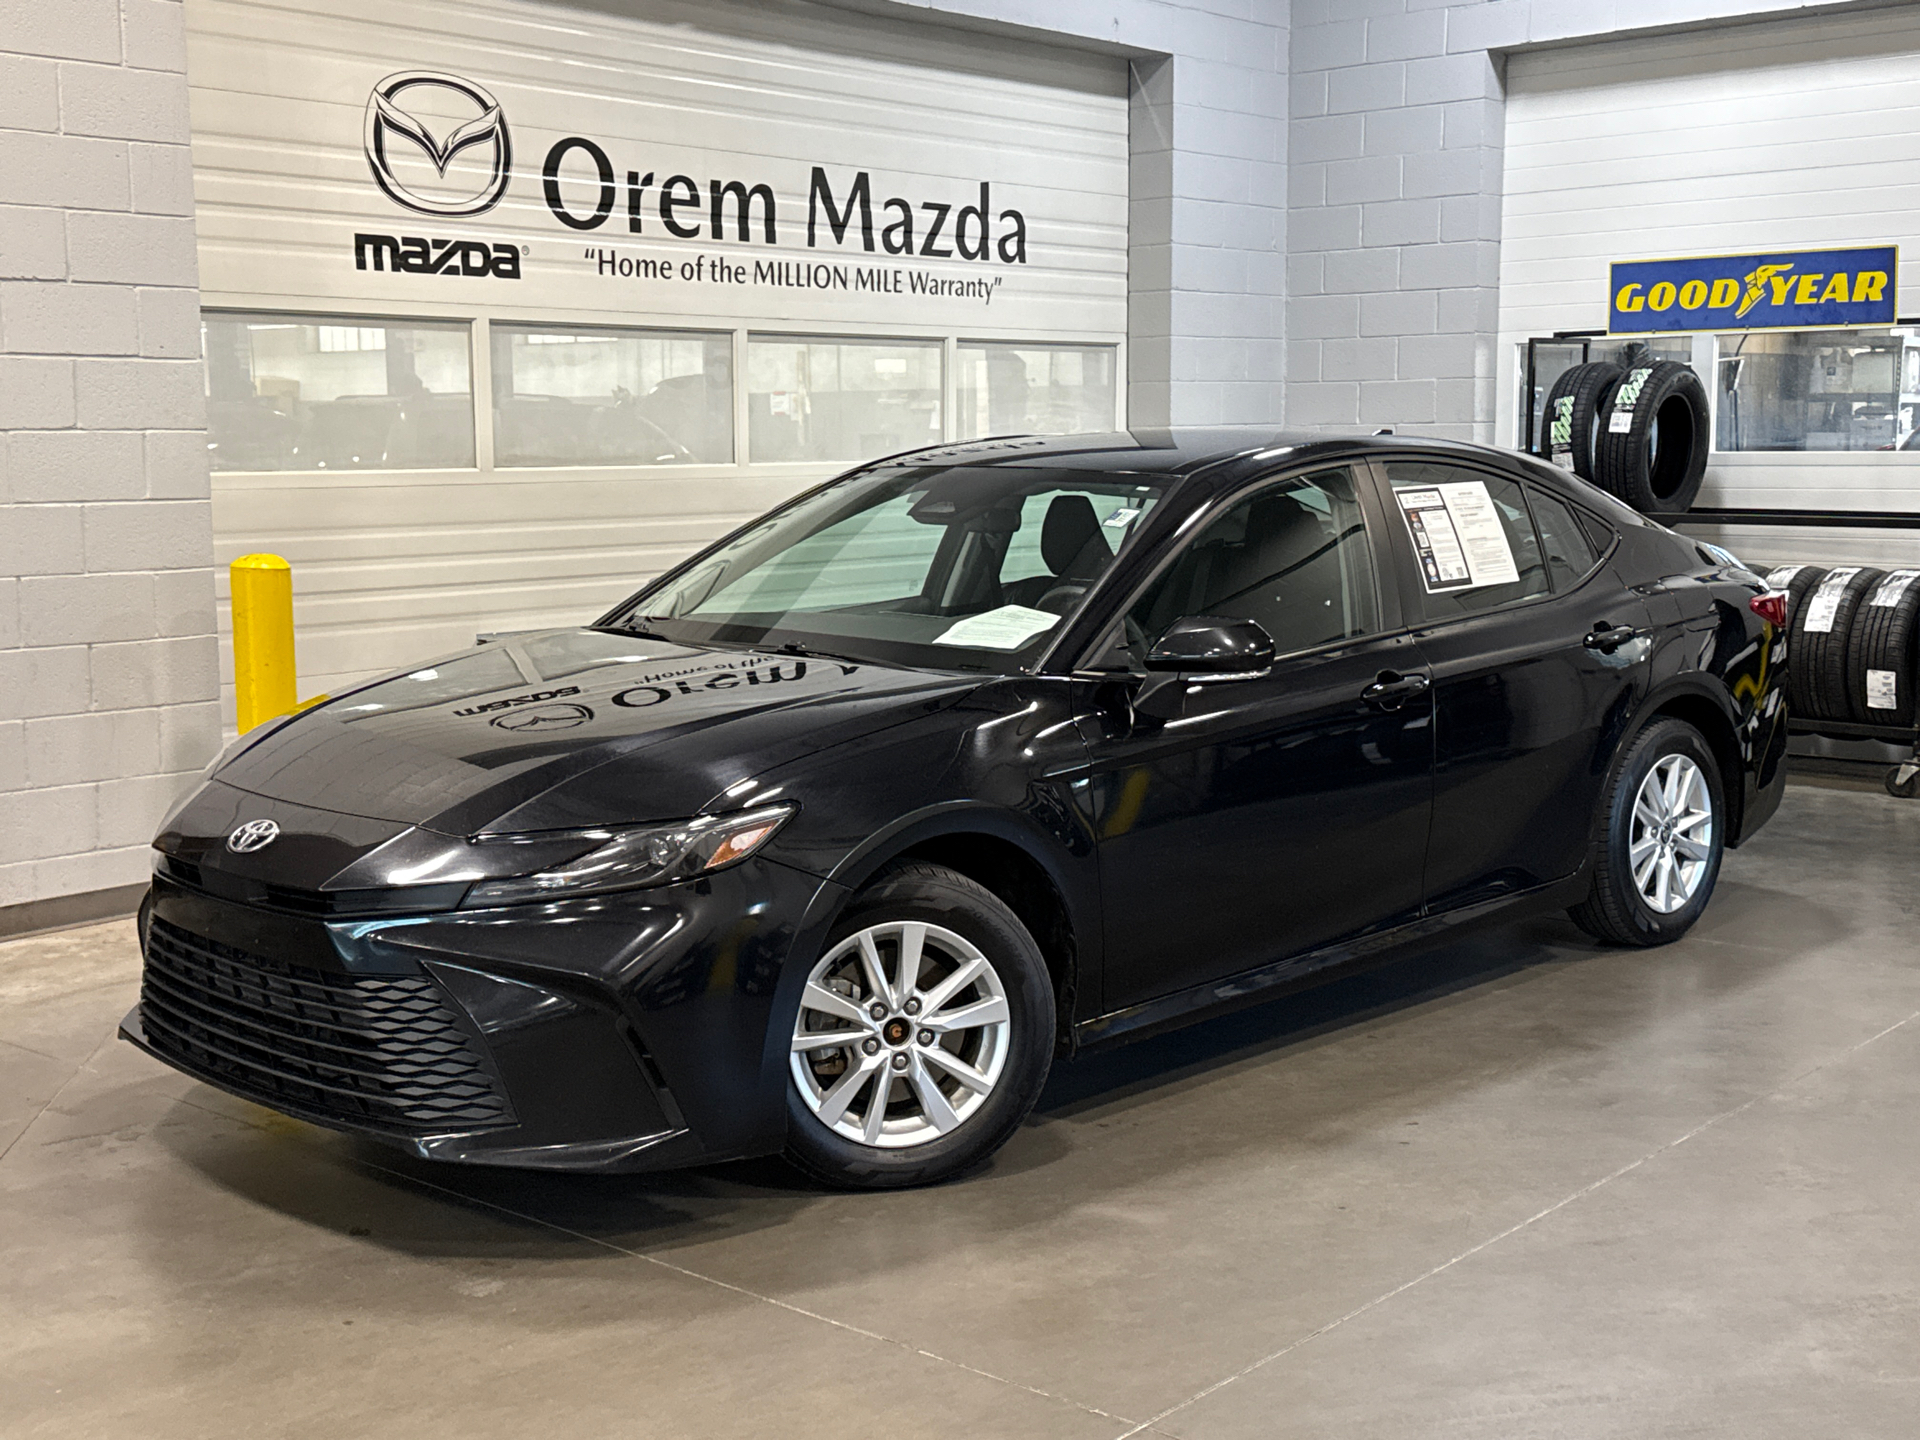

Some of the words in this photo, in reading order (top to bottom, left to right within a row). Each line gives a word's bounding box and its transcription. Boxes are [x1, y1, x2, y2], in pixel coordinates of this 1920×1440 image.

[542, 137, 776, 244] Orem
[807, 166, 1027, 264] Mazda
[354, 233, 521, 279] mazda
[584, 248, 673, 280] “Home
[680, 255, 705, 281] of
[710, 256, 746, 284] the
[753, 260, 848, 290] MILLION
[855, 267, 903, 293] MILE
